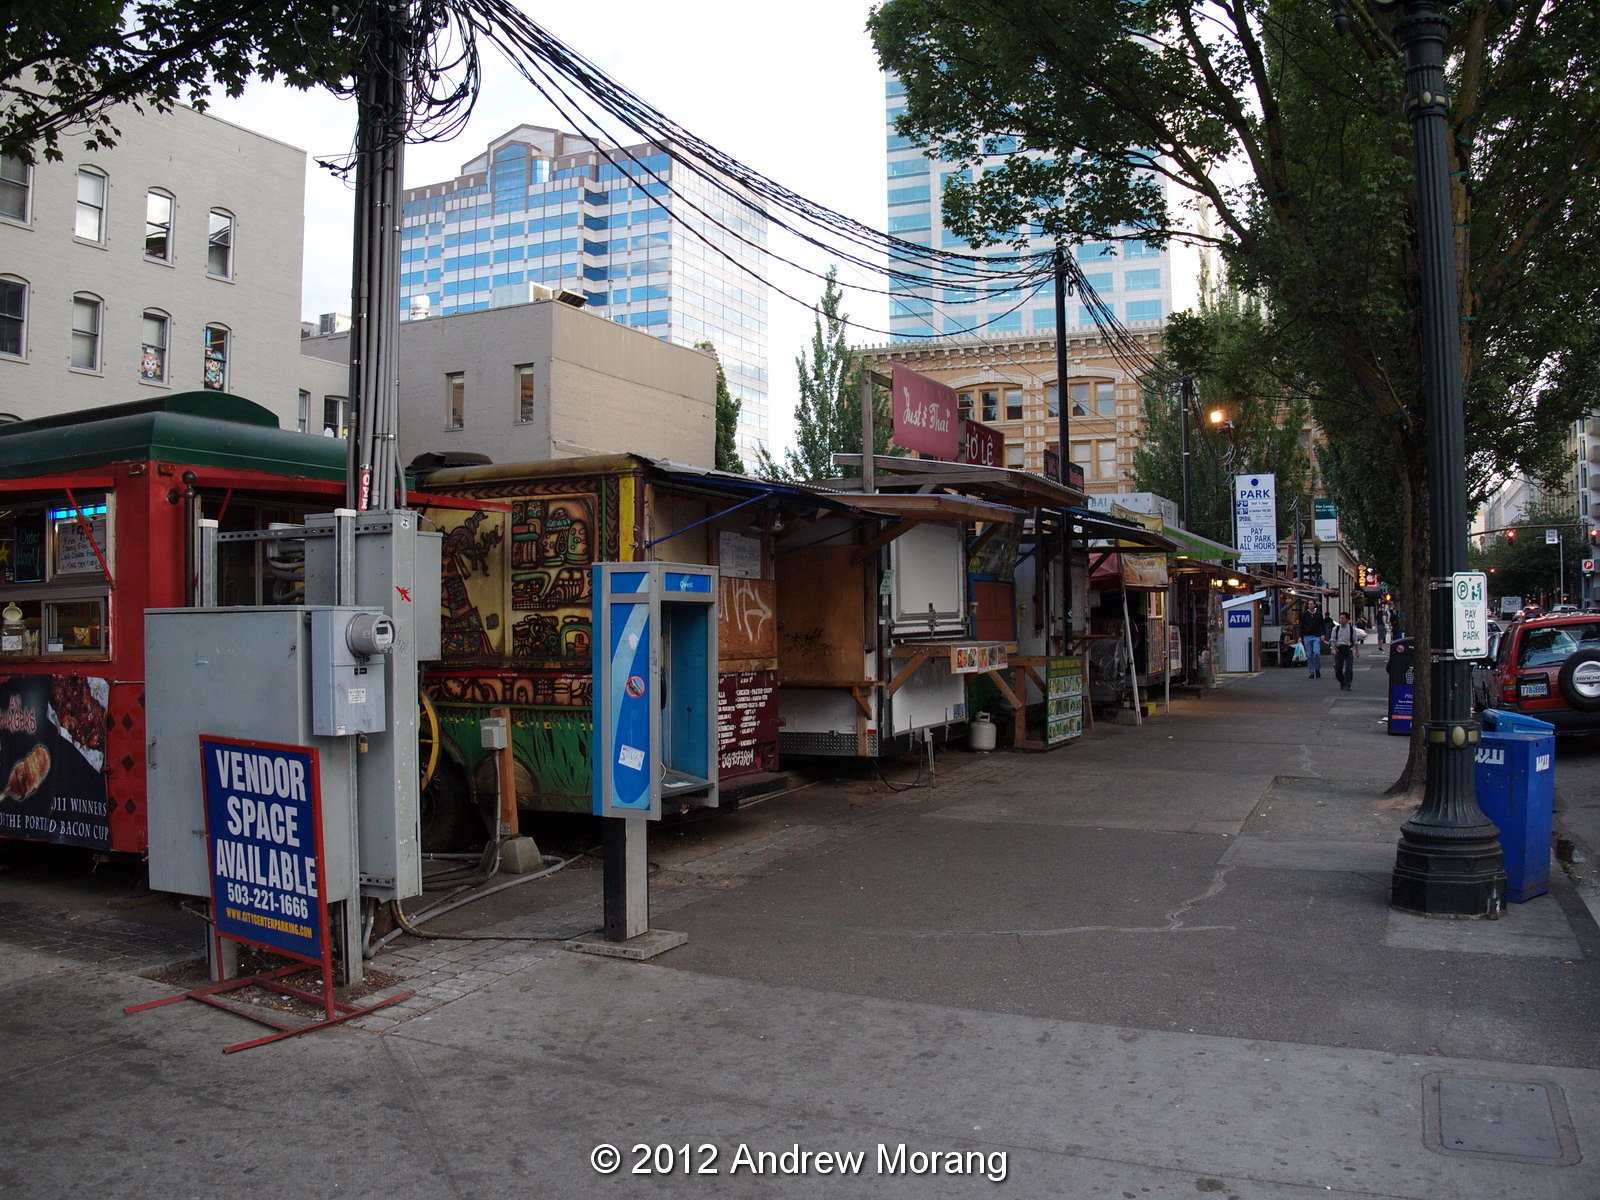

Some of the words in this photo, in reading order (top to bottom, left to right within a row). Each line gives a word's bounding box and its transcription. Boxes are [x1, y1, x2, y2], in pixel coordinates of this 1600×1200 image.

[929, 403, 950, 432] Thai
[1240, 489, 1270, 499] PARK
[1250, 527, 1263, 535] PAY
[1243, 535, 1252, 543] TO
[1253, 542, 1276, 550] HOURS
[1229, 614, 1250, 623] ATM
[1464, 609, 1477, 619] PAY
[1467, 620, 1476, 630] TO
[1463, 631, 1480, 641] PARK
[215, 749, 307, 802] VENDOR
[70, 797, 107, 817] WINNERS
[226, 795, 301, 848] SPACE
[60, 820, 91, 838] BACON
[93, 824, 109, 841] CUP
[216, 838, 319, 898] AVAILABLE
[227, 882, 309, 920] 503-221-1666
[225, 907, 313, 939] WWW.CITYCENTERPARKING.COM
